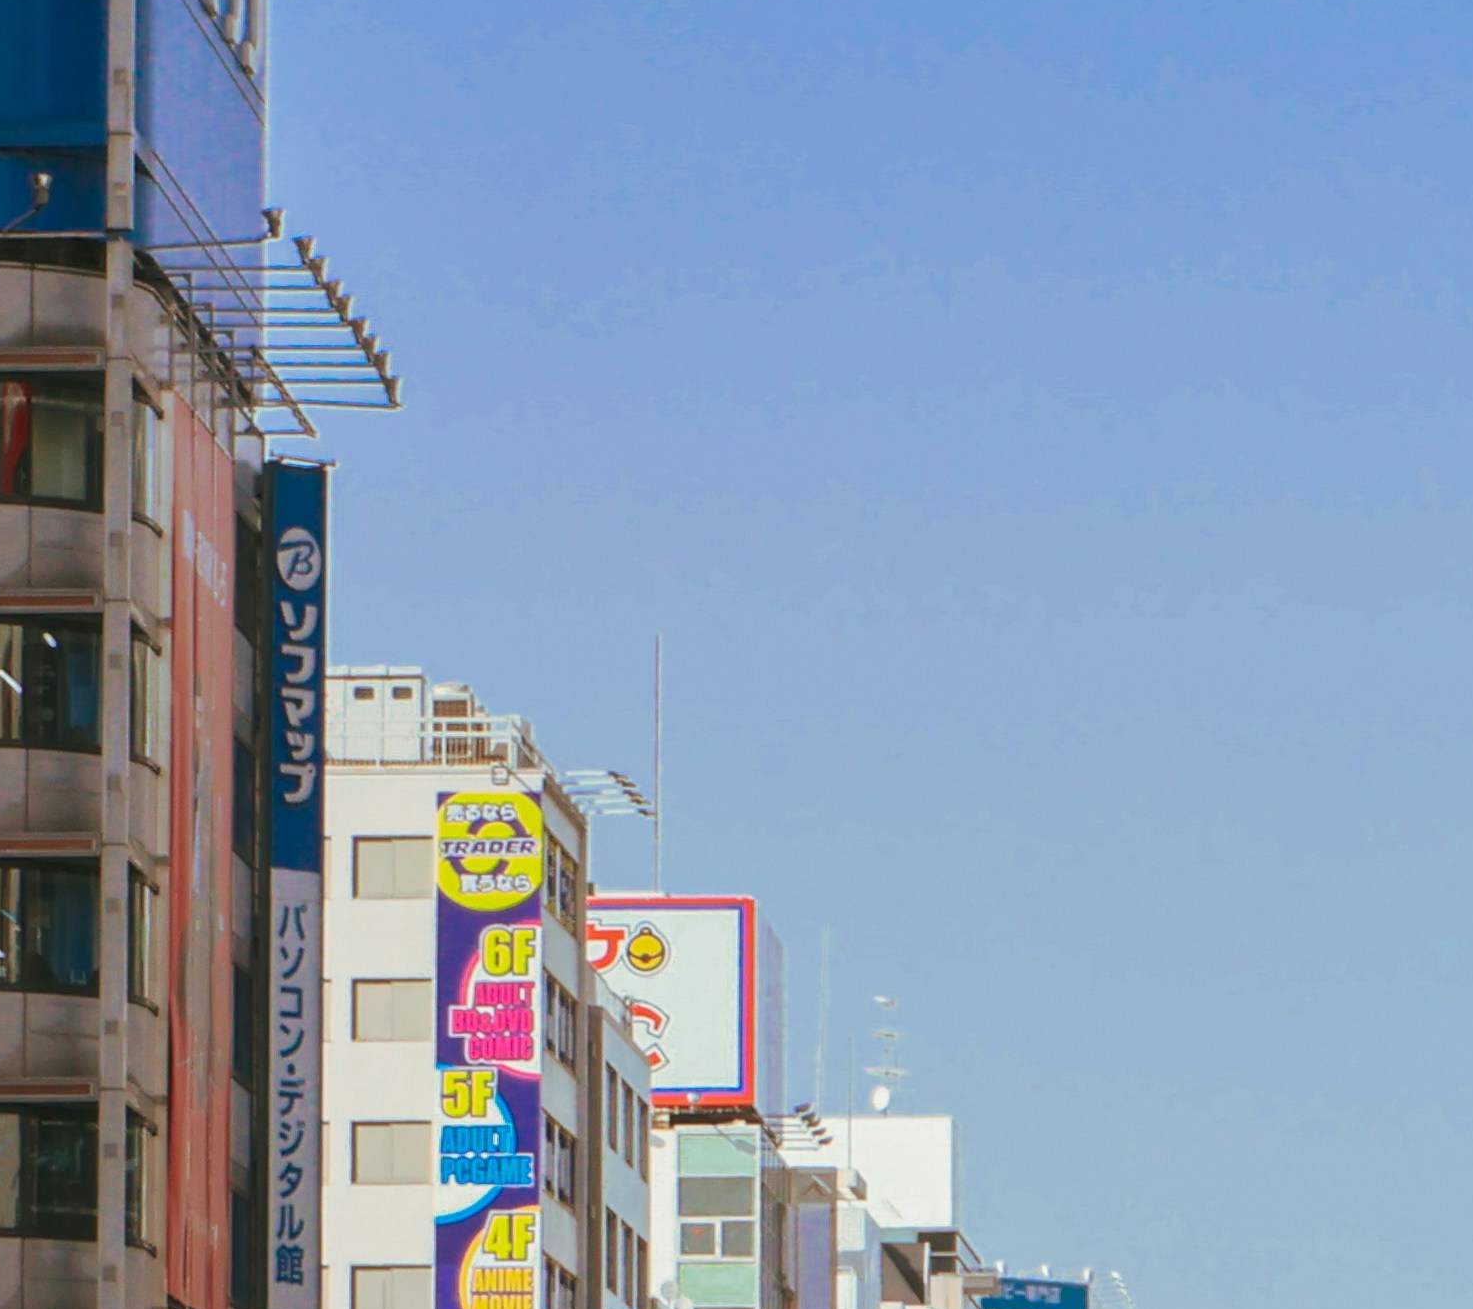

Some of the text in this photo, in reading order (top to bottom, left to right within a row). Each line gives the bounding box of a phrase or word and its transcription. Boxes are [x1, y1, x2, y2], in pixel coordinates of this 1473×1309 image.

[280, 601, 318, 804] ソフマップ
[441, 840, 536, 855] TRADER
[484, 928, 536, 976] 6F
[474, 982, 535, 1006] ADULT
[451, 1008, 534, 1033] BD&DVD
[469, 1035, 534, 1061] COMIC
[274, 904, 308, 1287] パソコン・デジタル館
[441, 1070, 495, 1119] 5F
[441, 1125, 512, 1154] ADULT
[440, 1155, 532, 1186] PCGAME
[483, 1214, 536, 1262] 4F
[472, 1268, 534, 1292] ANIME
